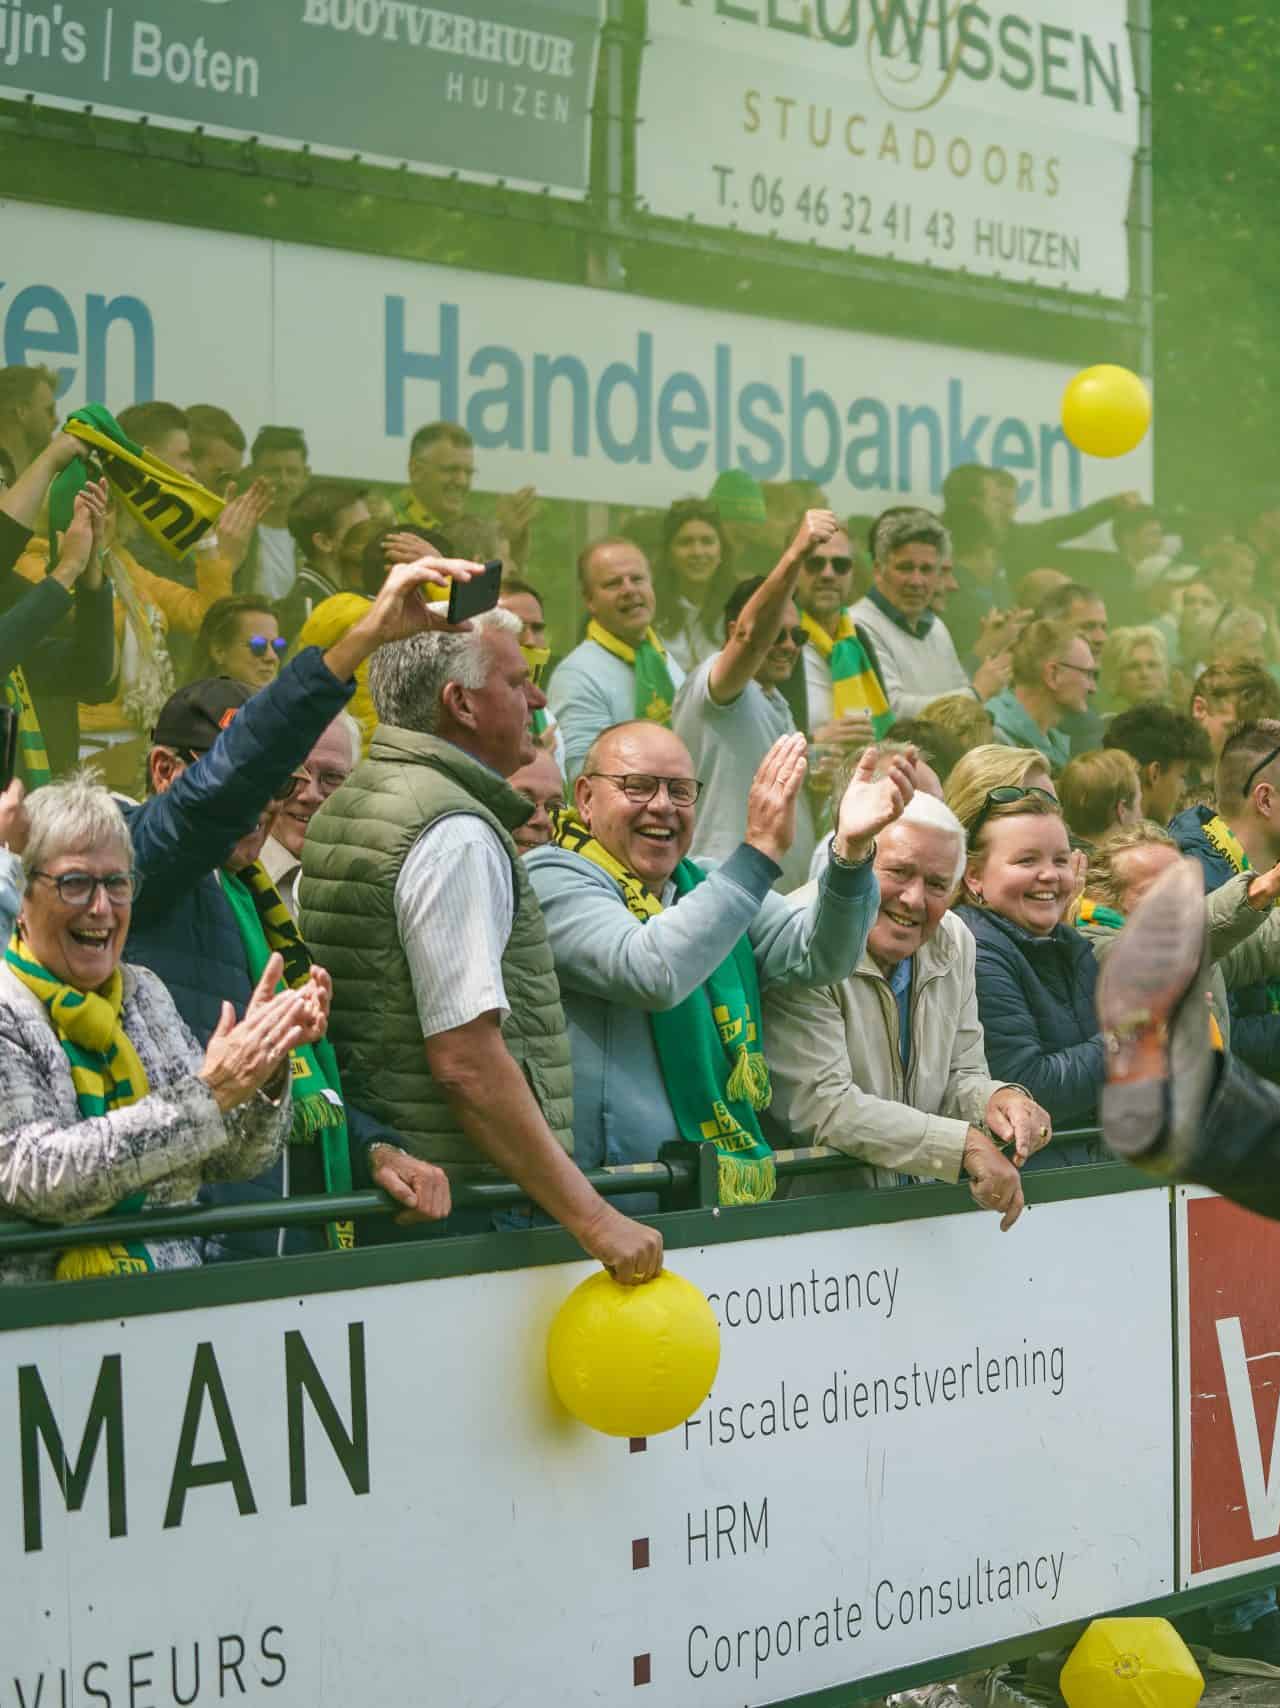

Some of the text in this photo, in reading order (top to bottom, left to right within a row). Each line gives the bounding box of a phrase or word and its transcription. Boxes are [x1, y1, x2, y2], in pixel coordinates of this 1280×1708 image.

[132, 20, 259, 97] Boten
[302, 0, 575, 77] BOOTVERHUUR
[678, 0, 1124, 113] UWISSEN
[447, 71, 570, 124] HUIZEN
[743, 89, 1061, 198] STUCADOORS
[750, 172, 785, 217] 06
[796, 182, 830, 226] 46
[841, 191, 873, 236] 32
[883, 202, 912, 243] 41
[925, 210, 956, 250] 43
[973, 218, 1081, 272] HUIZEN
[0, 280, 156, 405] en
[385, 294, 1083, 512] Handelsbanken
[707, 1267, 899, 1327] countancy
[822, 1339, 1065, 1424] dienstverlening
[18, 1321, 371, 1553] MAN
[686, 1497, 769, 1565] HRM
[687, 1551, 1065, 1680] Corporate Consultancy
[14, 1626, 287, 1708] VISEURS
